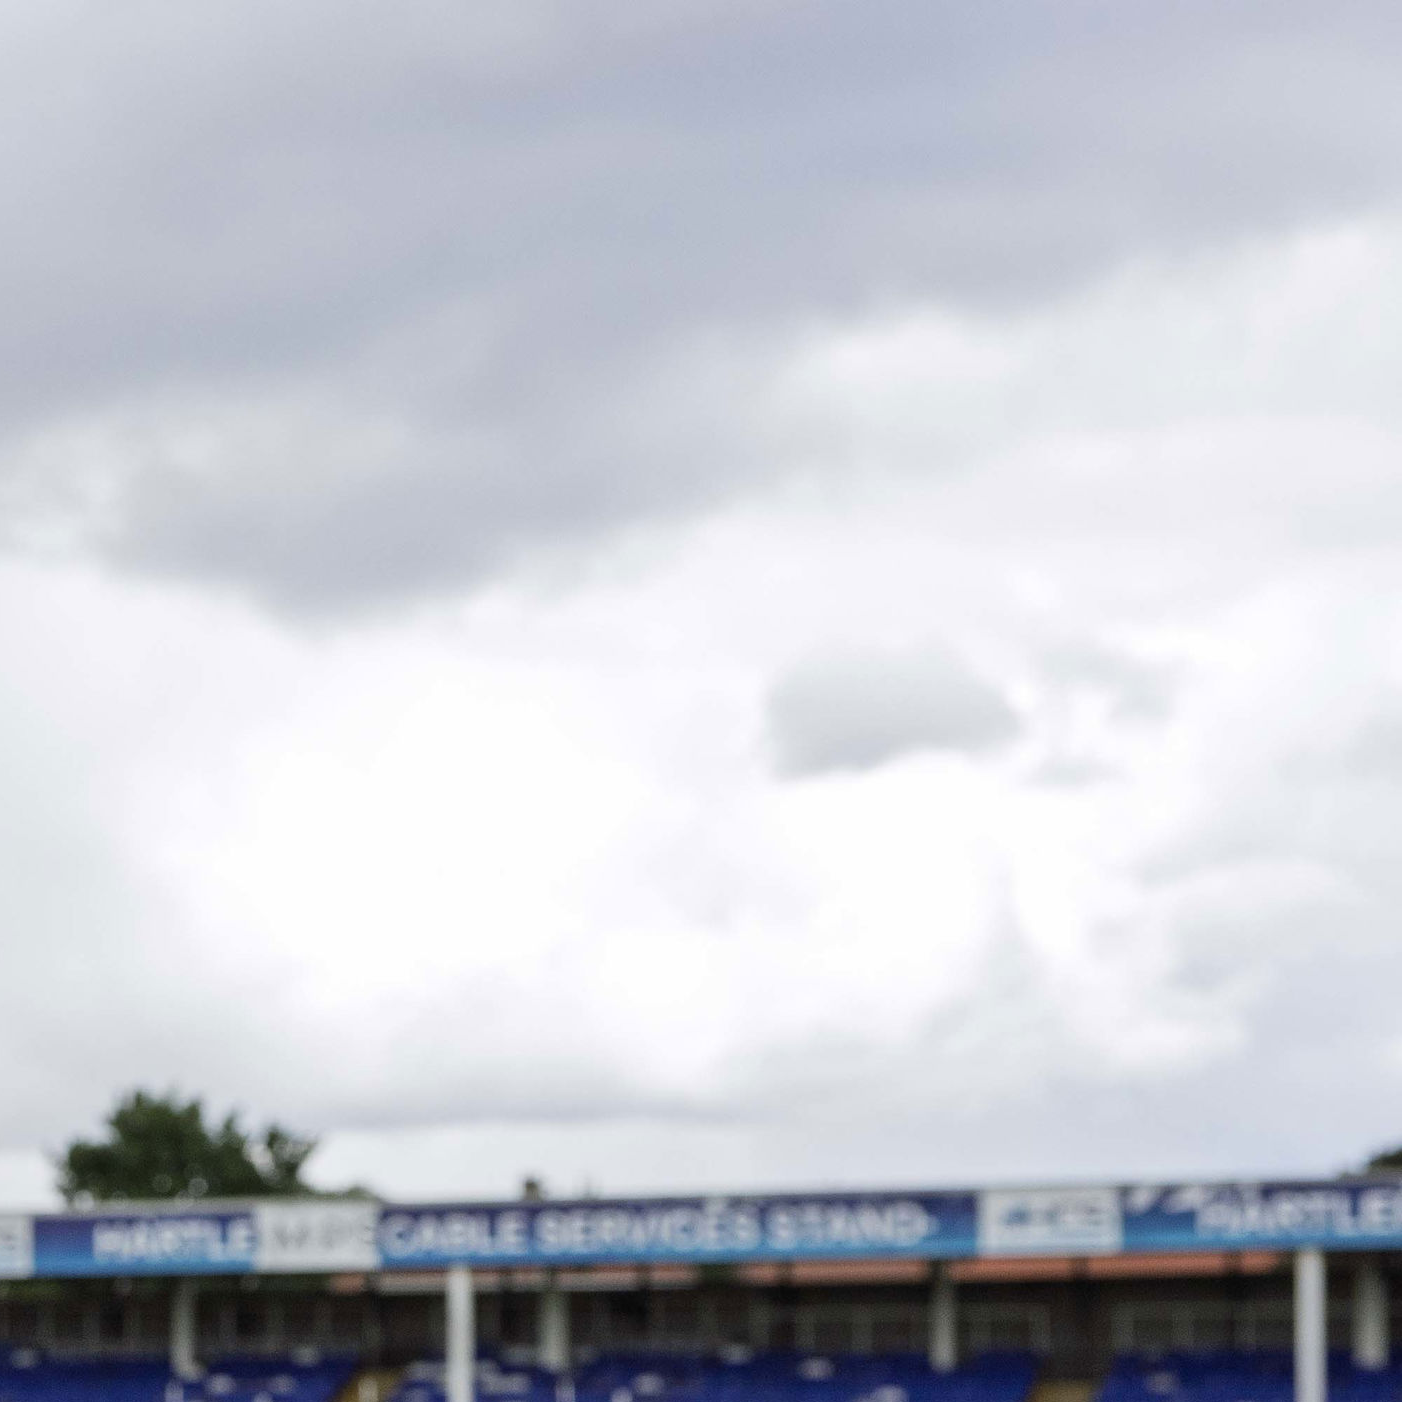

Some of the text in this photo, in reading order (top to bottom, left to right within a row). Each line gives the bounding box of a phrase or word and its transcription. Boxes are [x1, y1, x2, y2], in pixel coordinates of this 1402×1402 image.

[379, 1201, 931, 1256] CABLE SERVICES STAND
